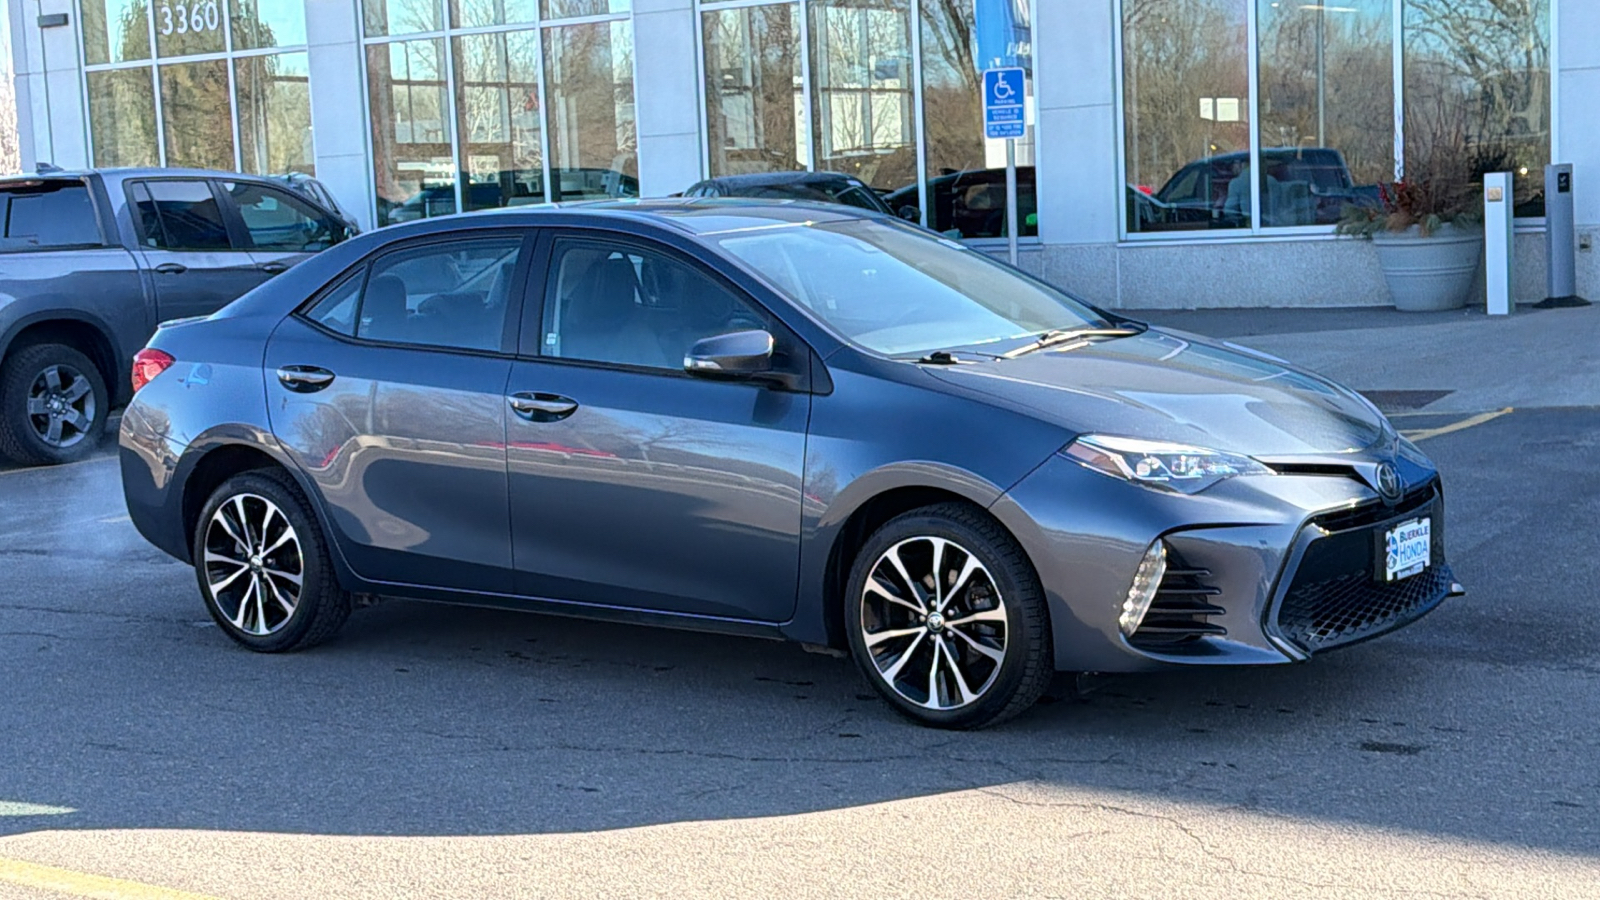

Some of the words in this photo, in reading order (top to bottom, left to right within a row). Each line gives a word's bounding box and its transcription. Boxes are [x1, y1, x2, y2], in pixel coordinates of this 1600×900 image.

[161, 2, 219, 35] 3360
[1400, 525, 1429, 543] BUERKLE
[1400, 540, 1428, 562] HONDA
